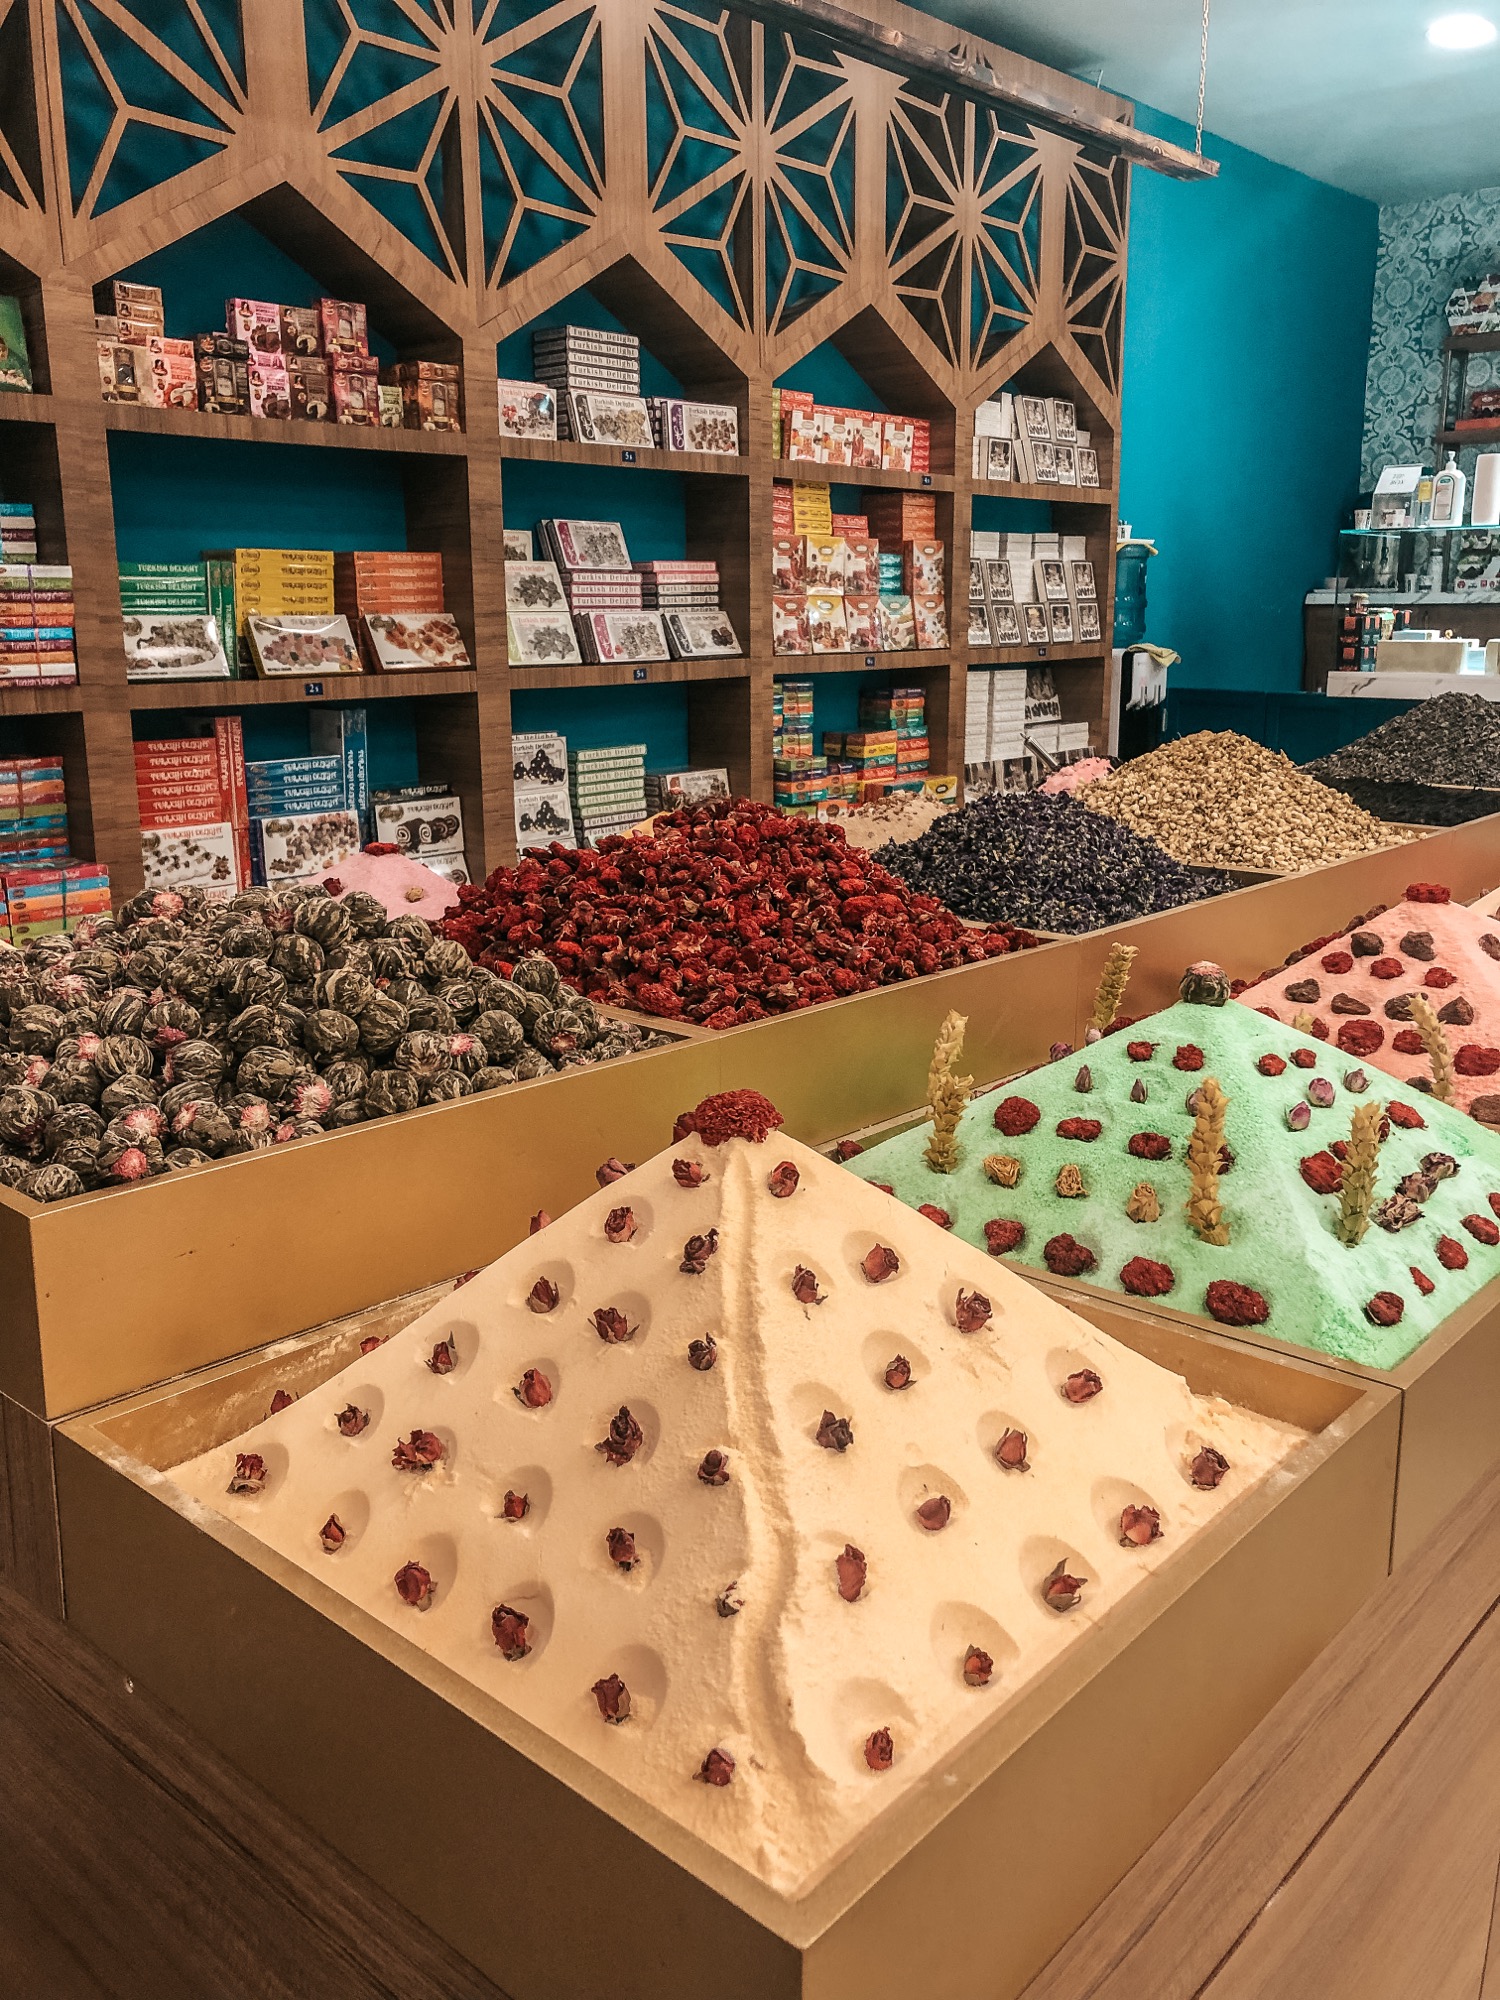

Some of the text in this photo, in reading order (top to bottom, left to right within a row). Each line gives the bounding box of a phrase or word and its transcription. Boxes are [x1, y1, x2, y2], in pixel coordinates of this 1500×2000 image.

[573, 328, 635, 343] Turkish Delight
[573, 341, 635, 356] Turkish Delight
[573, 354, 634, 368] Turkish Delight
[574, 365, 634, 380] Turkish Delight
[573, 378, 634, 392] Turkish Delight
[610, 574, 637, 582] Delight
[610, 598, 637, 606] Delight
[514, 744, 533, 752] Turkish
